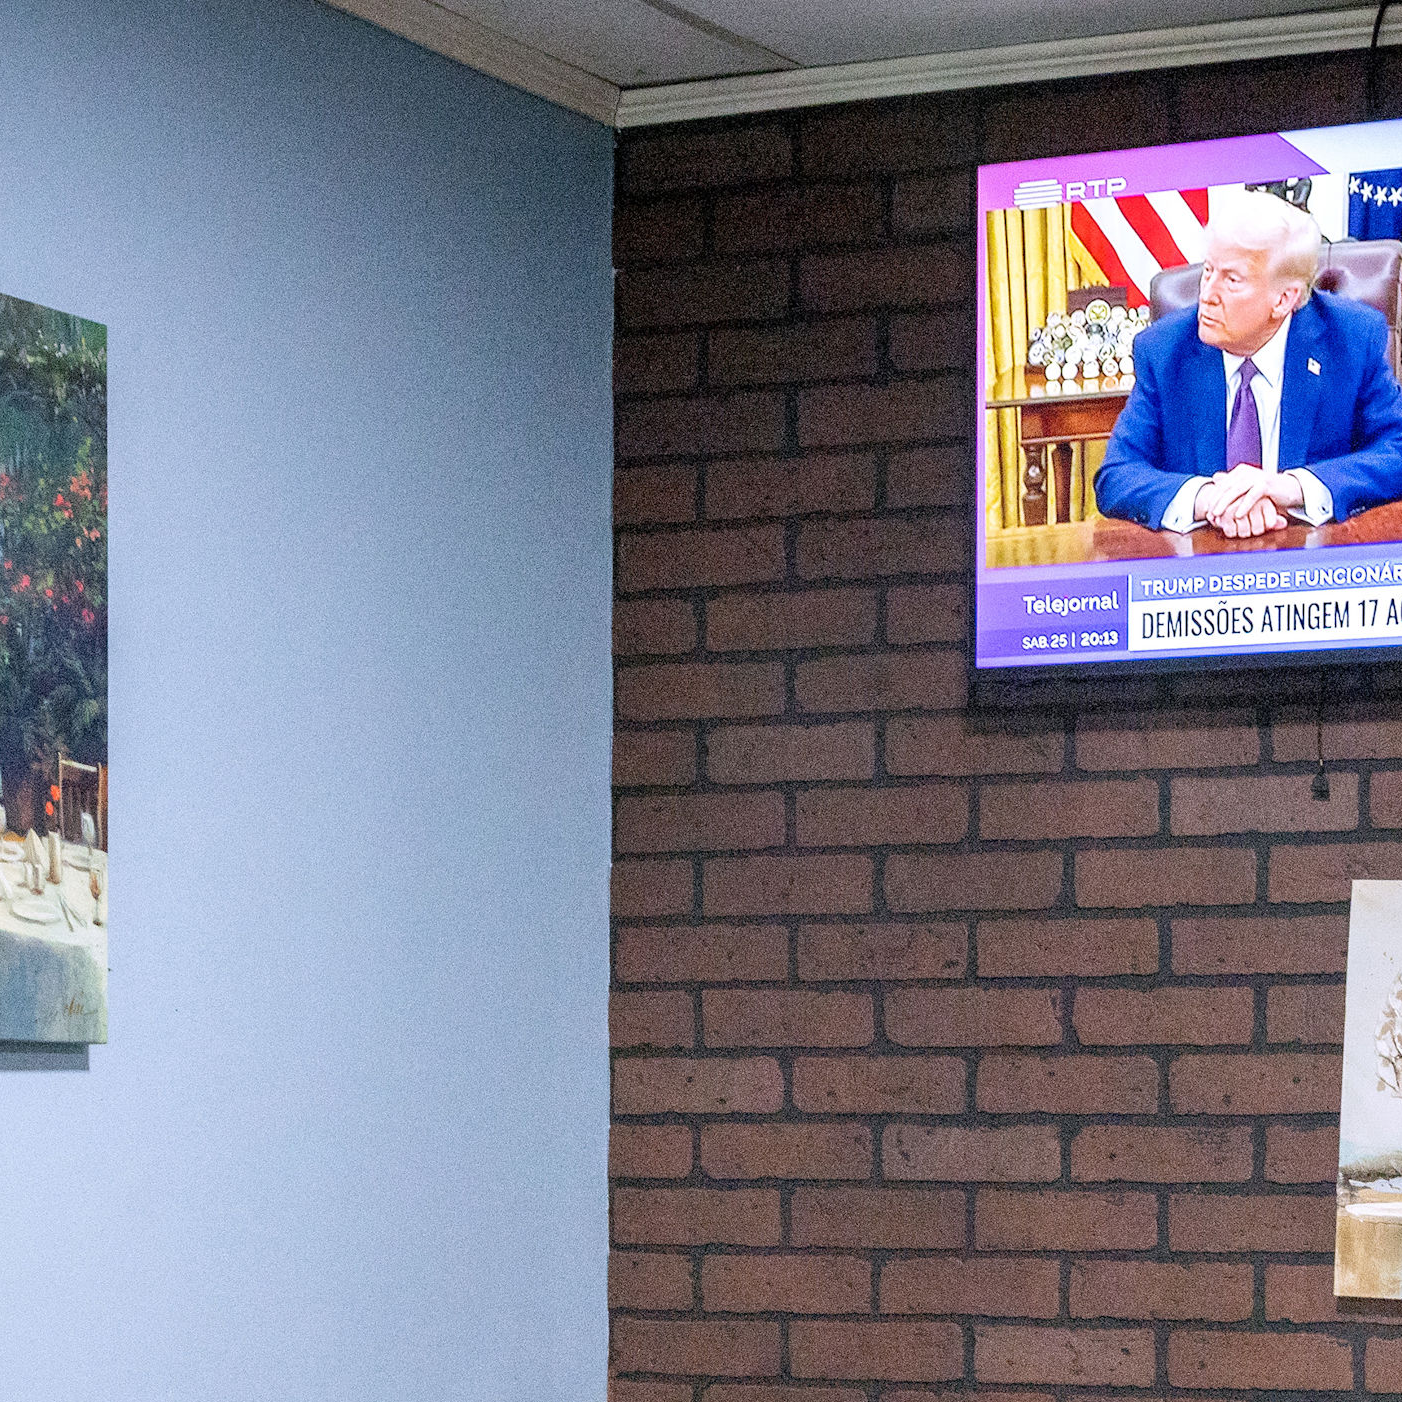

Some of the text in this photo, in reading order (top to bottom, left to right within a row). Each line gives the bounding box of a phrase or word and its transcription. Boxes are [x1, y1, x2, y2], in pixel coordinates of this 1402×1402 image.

[1065, 177, 1127, 201] RTP
[1141, 577, 1205, 597] TRUMP
[1208, 570, 1292, 593] DESPEDE
[1022, 591, 1119, 617] Telejornal
[1141, 601, 1254, 640] DEMISSÕES
[1260, 601, 1351, 634] ATINGEM
[1357, 600, 1378, 628] 17
[1080, 630, 1119, 648] 20:13
